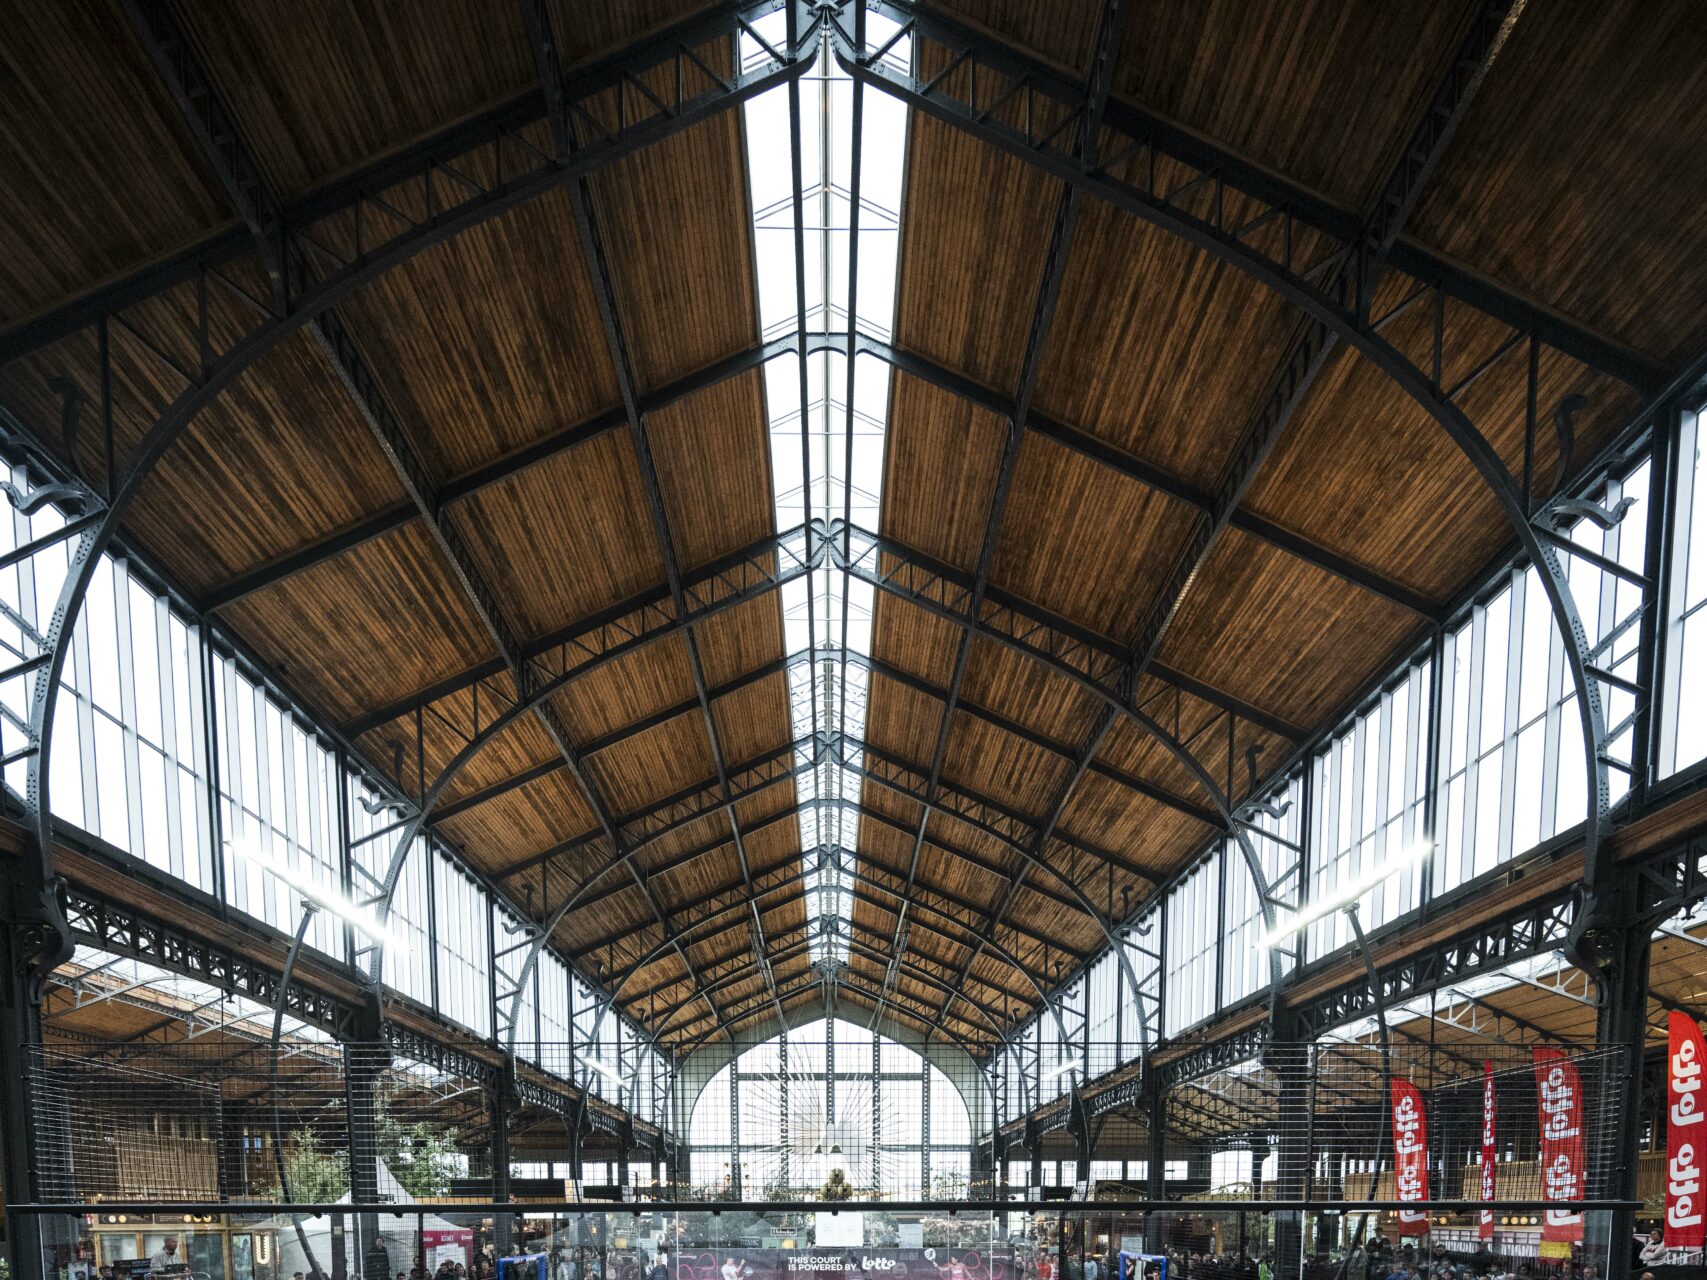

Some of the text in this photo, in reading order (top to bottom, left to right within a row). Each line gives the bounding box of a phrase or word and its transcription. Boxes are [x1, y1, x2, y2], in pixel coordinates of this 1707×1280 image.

[810, 1256, 842, 1264] COURT
[788, 1263, 857, 1271] IS POWERED BY
